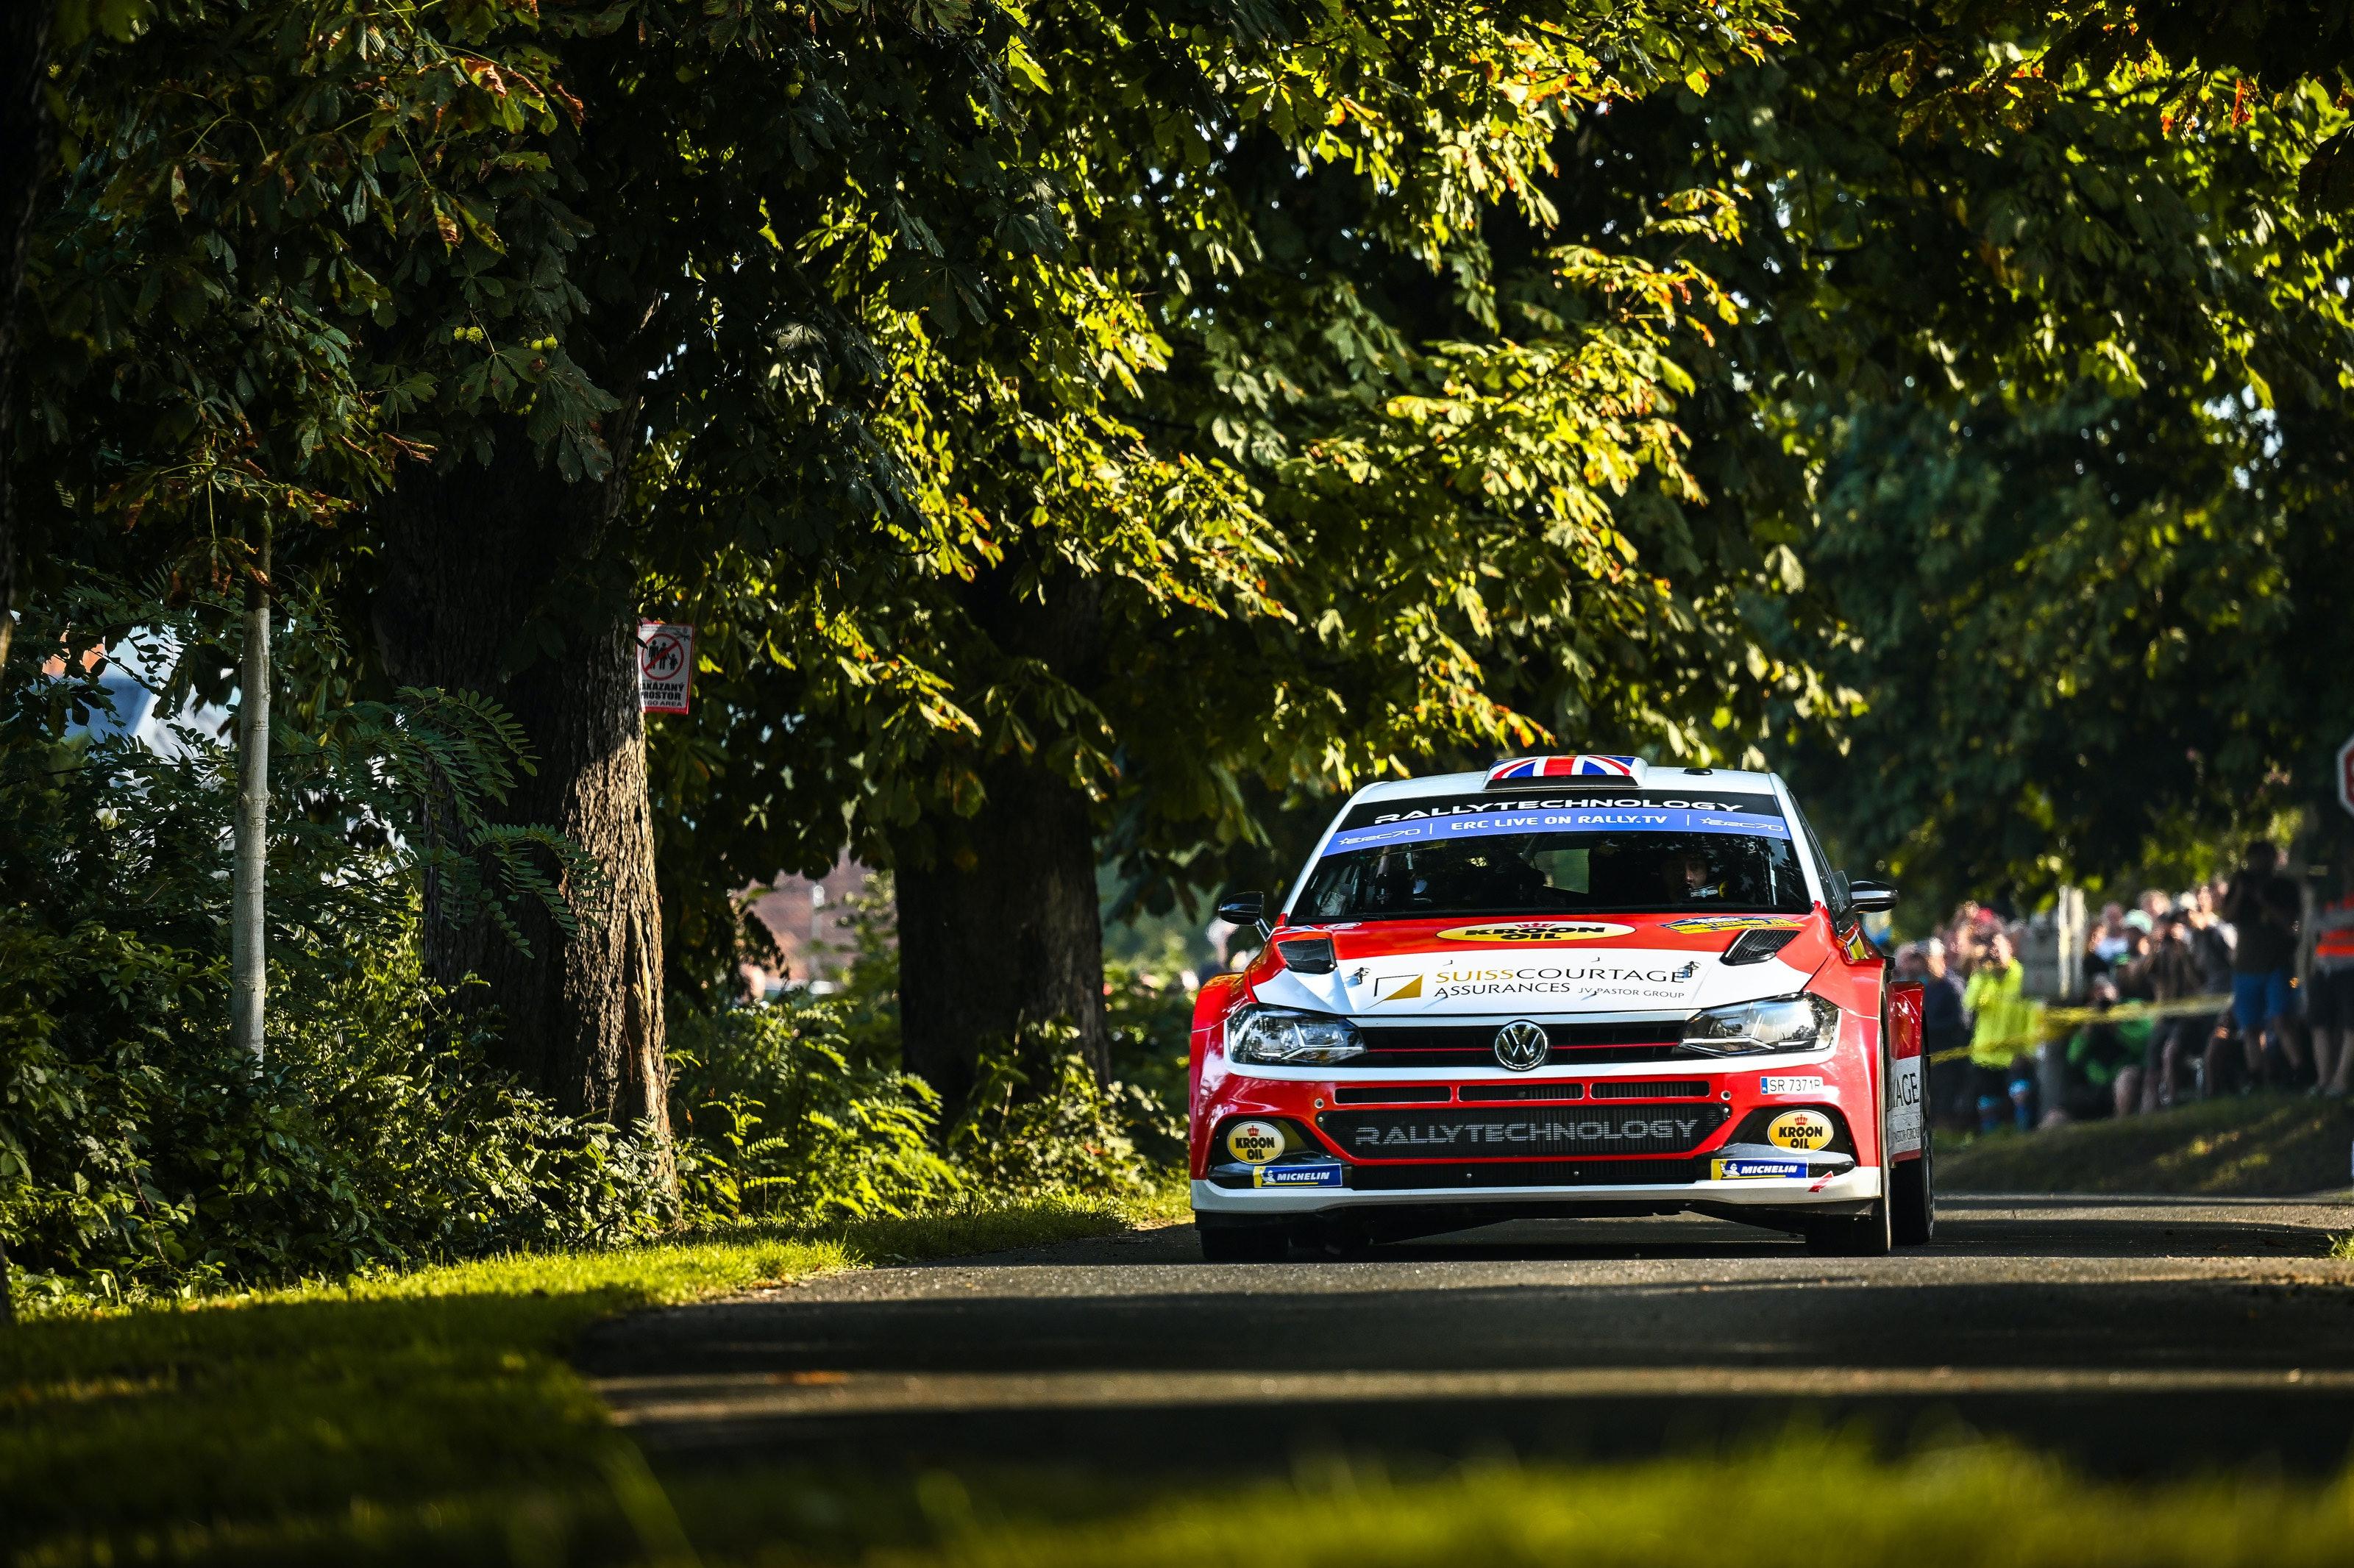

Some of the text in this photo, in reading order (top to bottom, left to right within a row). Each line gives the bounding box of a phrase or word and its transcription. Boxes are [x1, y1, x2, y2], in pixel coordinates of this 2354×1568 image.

[1374, 799, 1743, 824] RALLYTECHNOLOGY
[1451, 815, 1668, 830] ERC LIVE ON RALLY.TV
[1465, 927, 1606, 936] KROON
[1435, 968, 1685, 983] SUISSCOURTAGE
[1434, 983, 1571, 997] ASSURANCES
[1596, 988, 1639, 996] PASTOR
[1643, 990, 1685, 998] GROUP
[1769, 1079, 1785, 1091] SR
[1355, 1119, 1699, 1146] RALLYTECHNOLOGY
[1779, 1126, 1823, 1137] KROON
[1235, 1137, 1275, 1148] KROON
[1790, 1138, 1810, 1149] OIL
[1246, 1149, 1265, 1161] OIL
[1740, 1165, 1797, 1174] MICHELIN
[1277, 1172, 1330, 1181] MICHELIN
